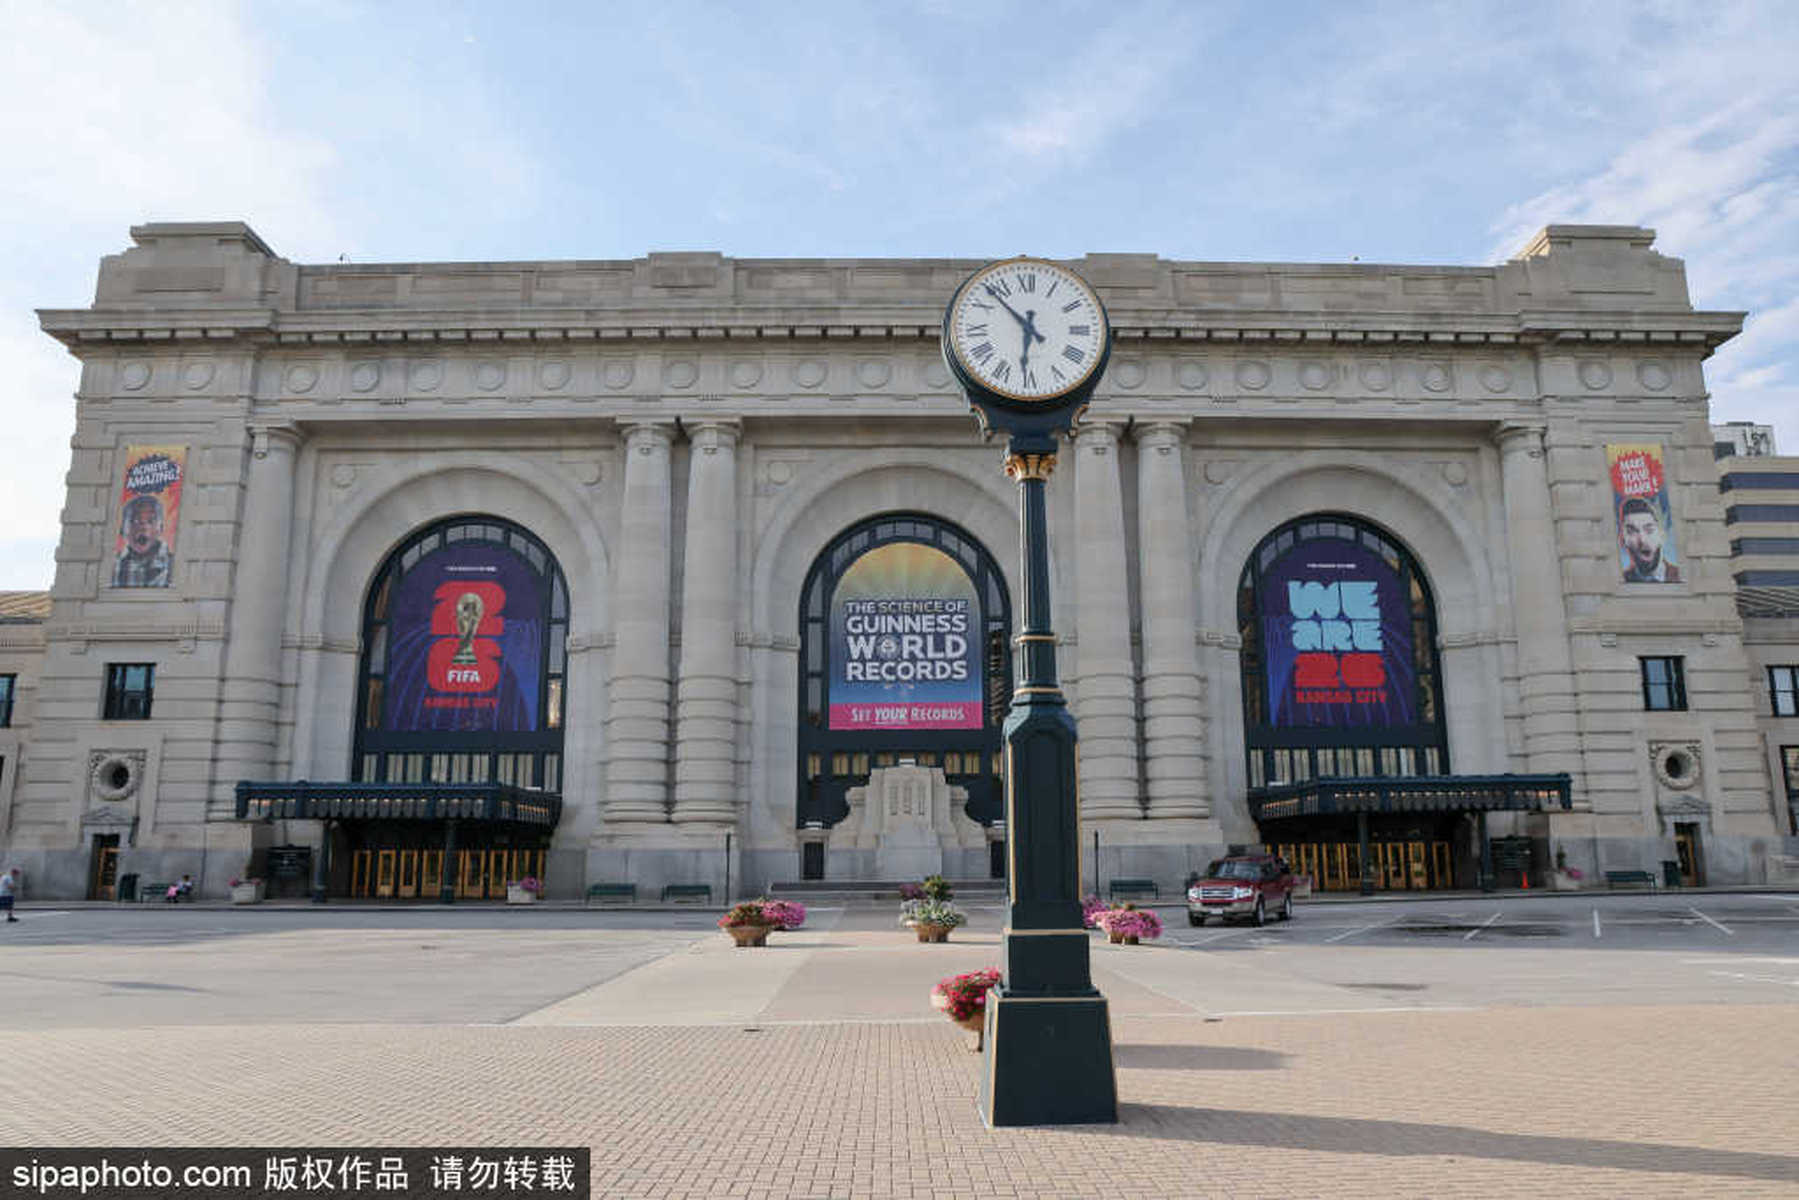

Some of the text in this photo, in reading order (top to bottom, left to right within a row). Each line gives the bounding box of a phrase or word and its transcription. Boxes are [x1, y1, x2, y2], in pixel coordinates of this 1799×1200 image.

[1017, 274, 1036, 293] XII
[847, 601, 967, 613] THE SCIENCE OF
[1288, 580, 1381, 619] WE
[846, 614, 967, 633] GUINNESS
[1292, 620, 1383, 651] ARE
[847, 634, 967, 660] WORLD
[447, 669, 480, 683] FIFA
[846, 661, 967, 681] RECORDS
[875, 707, 907, 721] YOUR
[911, 707, 965, 721] RECORDS
